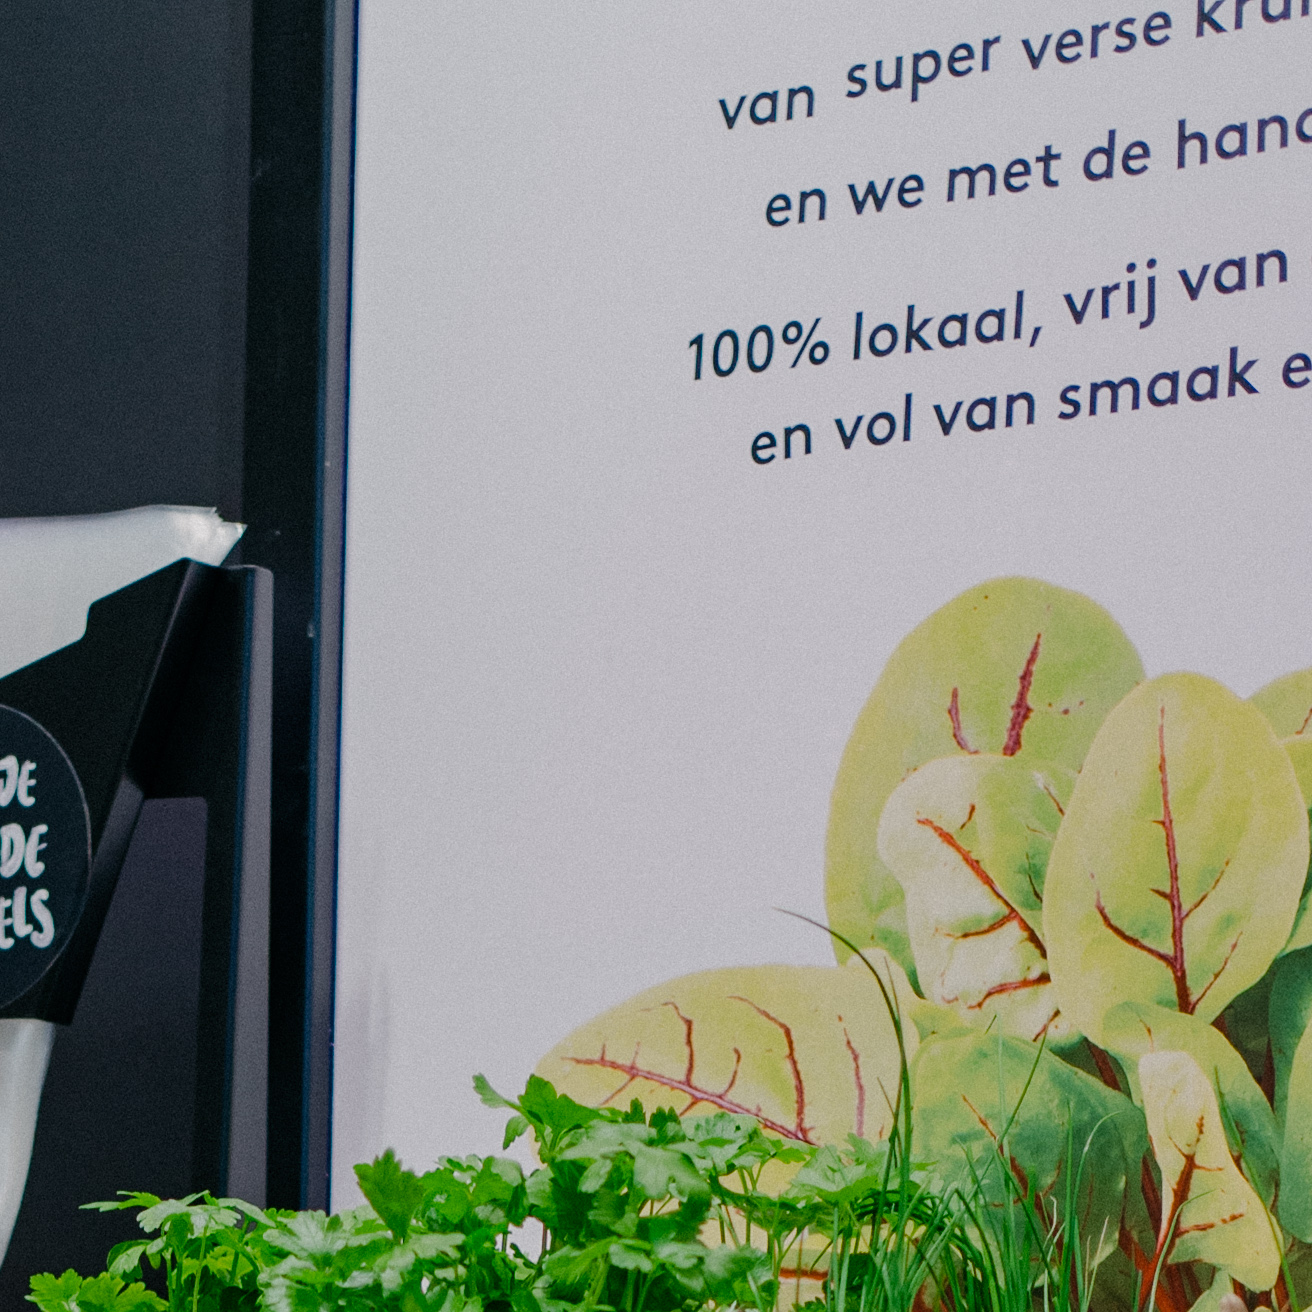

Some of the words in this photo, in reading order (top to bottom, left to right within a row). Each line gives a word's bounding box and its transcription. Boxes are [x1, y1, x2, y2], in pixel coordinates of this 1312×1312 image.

[719, 84, 815, 130] van
[846, 36, 1002, 103] super
[1021, 11, 1173, 71] verse
[765, 187, 827, 228] en
[848, 174, 925, 215] we
[946, 145, 1063, 202] met
[1082, 129, 1152, 182] de
[687, 317, 831, 381] 100%
[852, 289, 1043, 361] lokaal,
[1062, 258, 1158, 330] vrij
[1177, 248, 1289, 302] van
[750, 420, 813, 466] en
[834, 393, 913, 451] vol
[932, 389, 1036, 437] van
[1057, 345, 1261, 420] smaak
[0, 823, 50, 880] DE
